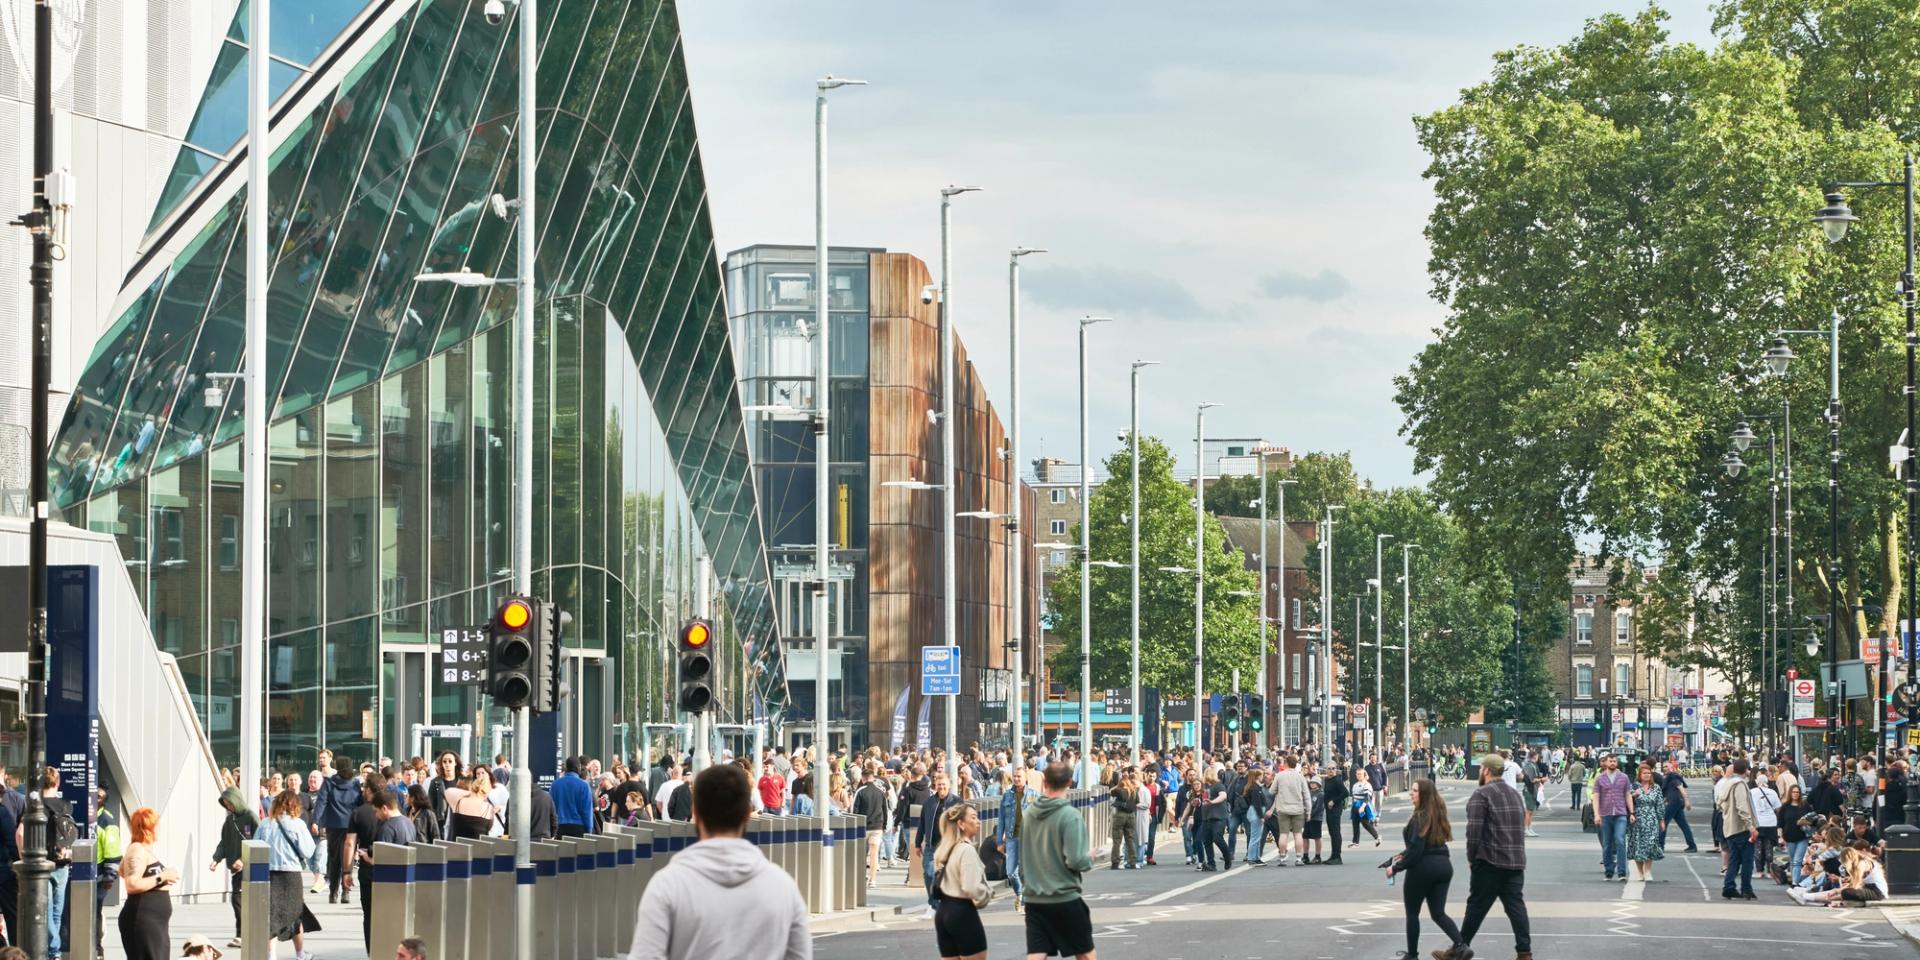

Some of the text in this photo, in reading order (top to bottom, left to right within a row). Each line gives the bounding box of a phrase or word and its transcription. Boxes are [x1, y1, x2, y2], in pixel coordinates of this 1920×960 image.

[462, 630, 484, 642] 1-5
[1788, 669, 1796, 679] T
[894, 720, 905, 732] 23
[919, 727, 929, 737] 23
[1909, 730, 1920, 744] H
